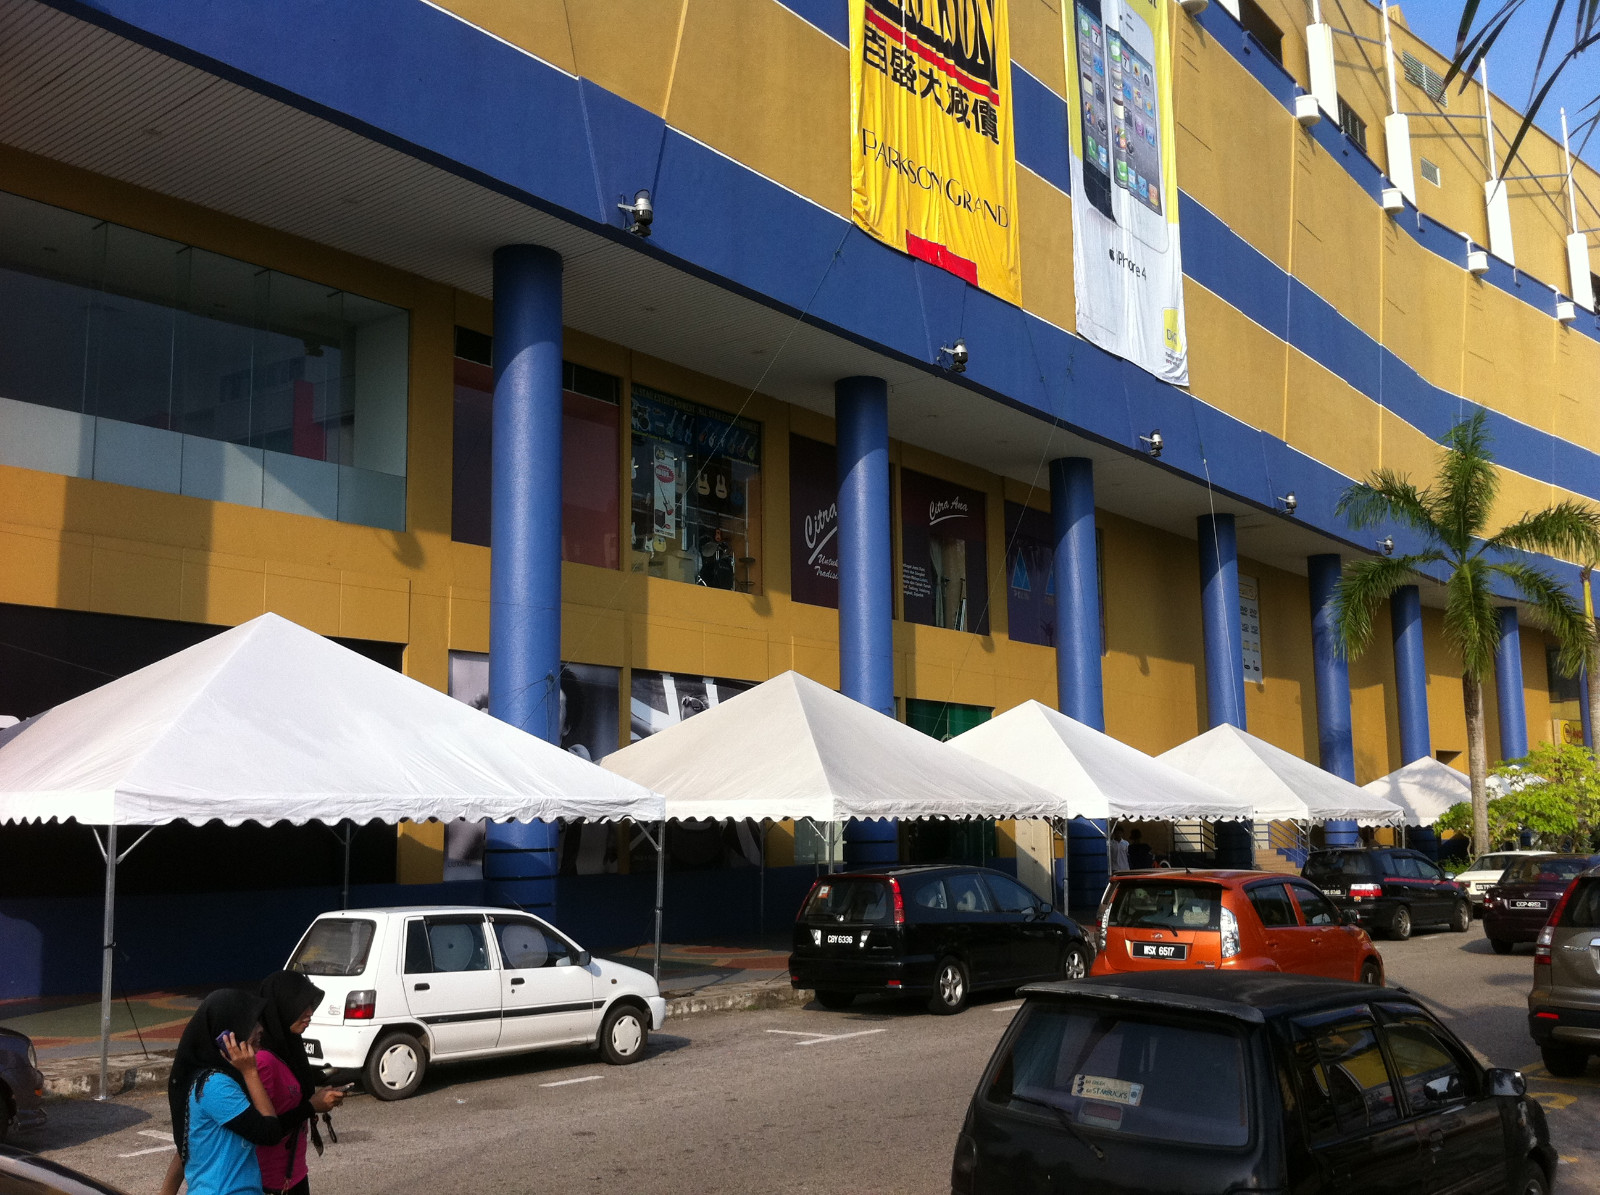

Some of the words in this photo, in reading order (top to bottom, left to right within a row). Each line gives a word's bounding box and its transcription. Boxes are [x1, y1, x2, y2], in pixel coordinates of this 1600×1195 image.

[862, 128, 943, 195] PARKSON
[945, 178, 1009, 228] GRAND
[929, 501, 949, 521] Citra
[805, 503, 838, 549] Citra
[838, 935, 853, 944] 6336
[1143, 945, 1156, 955] WSX
[1158, 946, 1175, 957] 6517
[303, 1042, 315, 1055] 431
